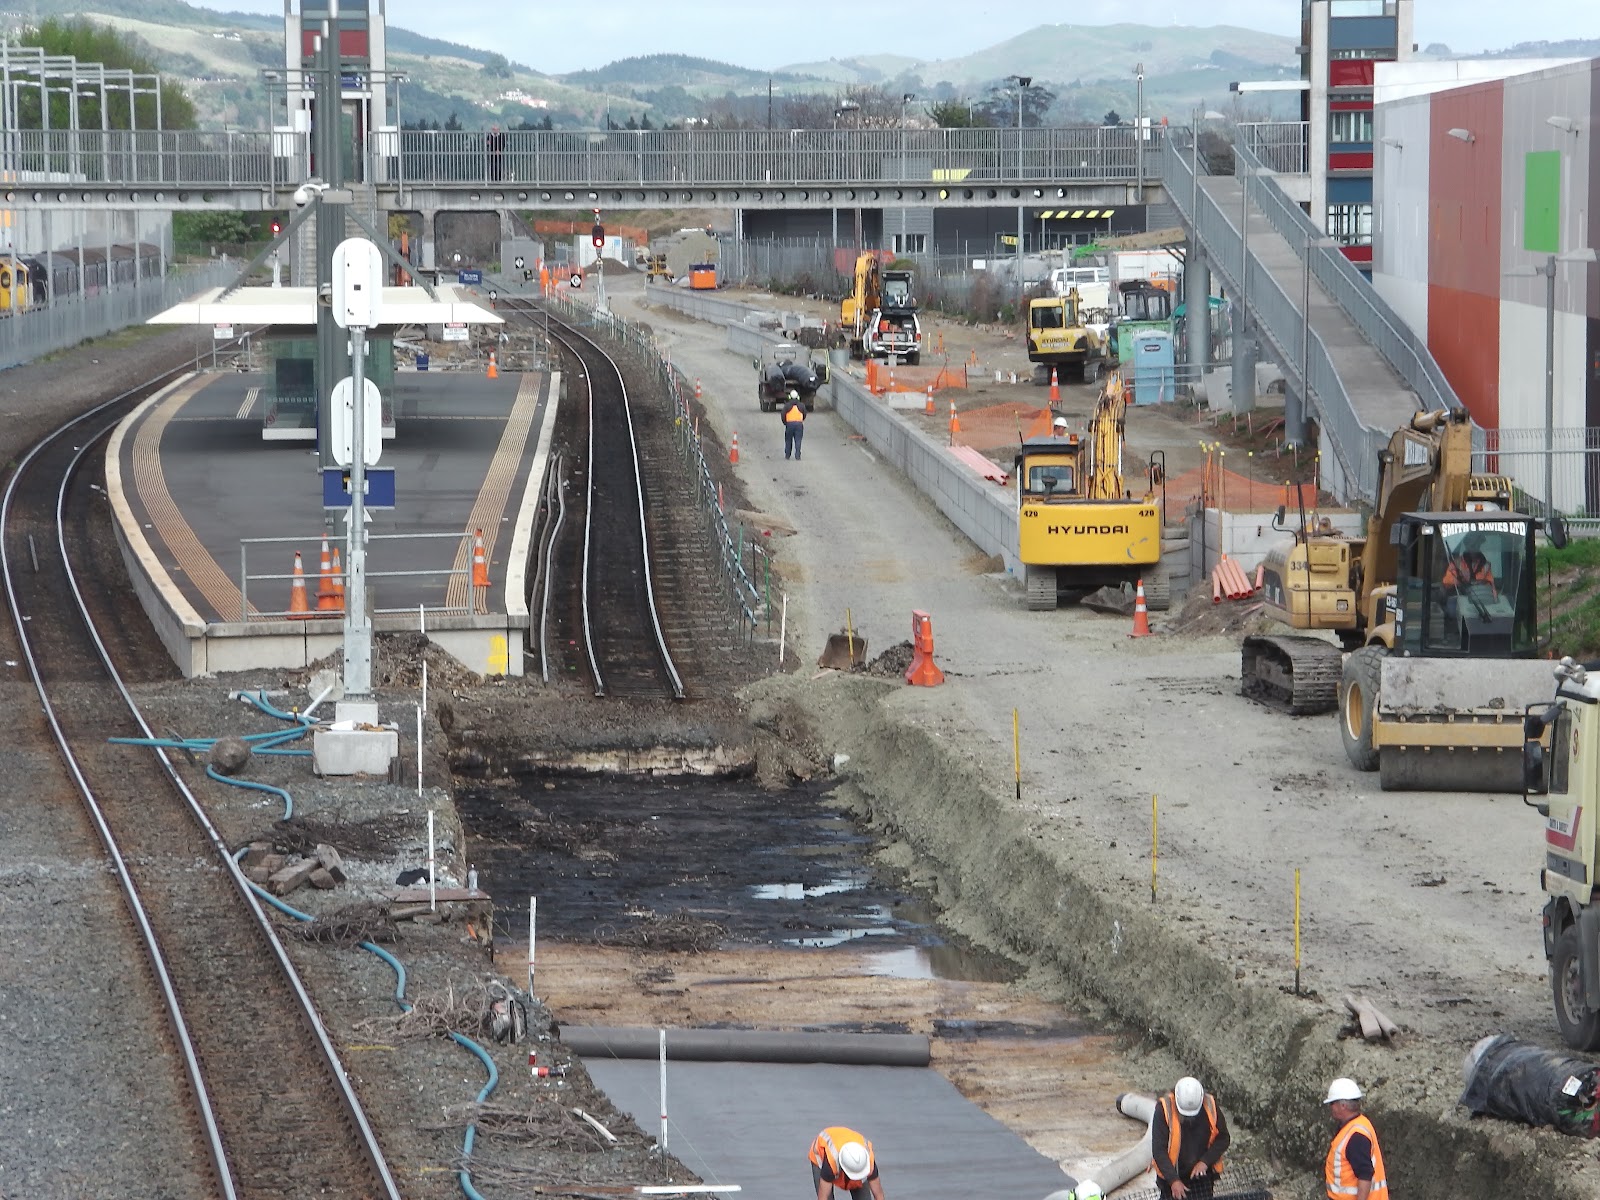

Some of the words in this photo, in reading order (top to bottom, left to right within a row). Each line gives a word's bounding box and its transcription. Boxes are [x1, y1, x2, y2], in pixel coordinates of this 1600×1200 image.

[1047, 525, 1129, 535] HYUNDAI
[1441, 523, 1469, 537] SMITH
[1478, 522, 1509, 532] DAVIES
[1509, 521, 1526, 537] LTD
